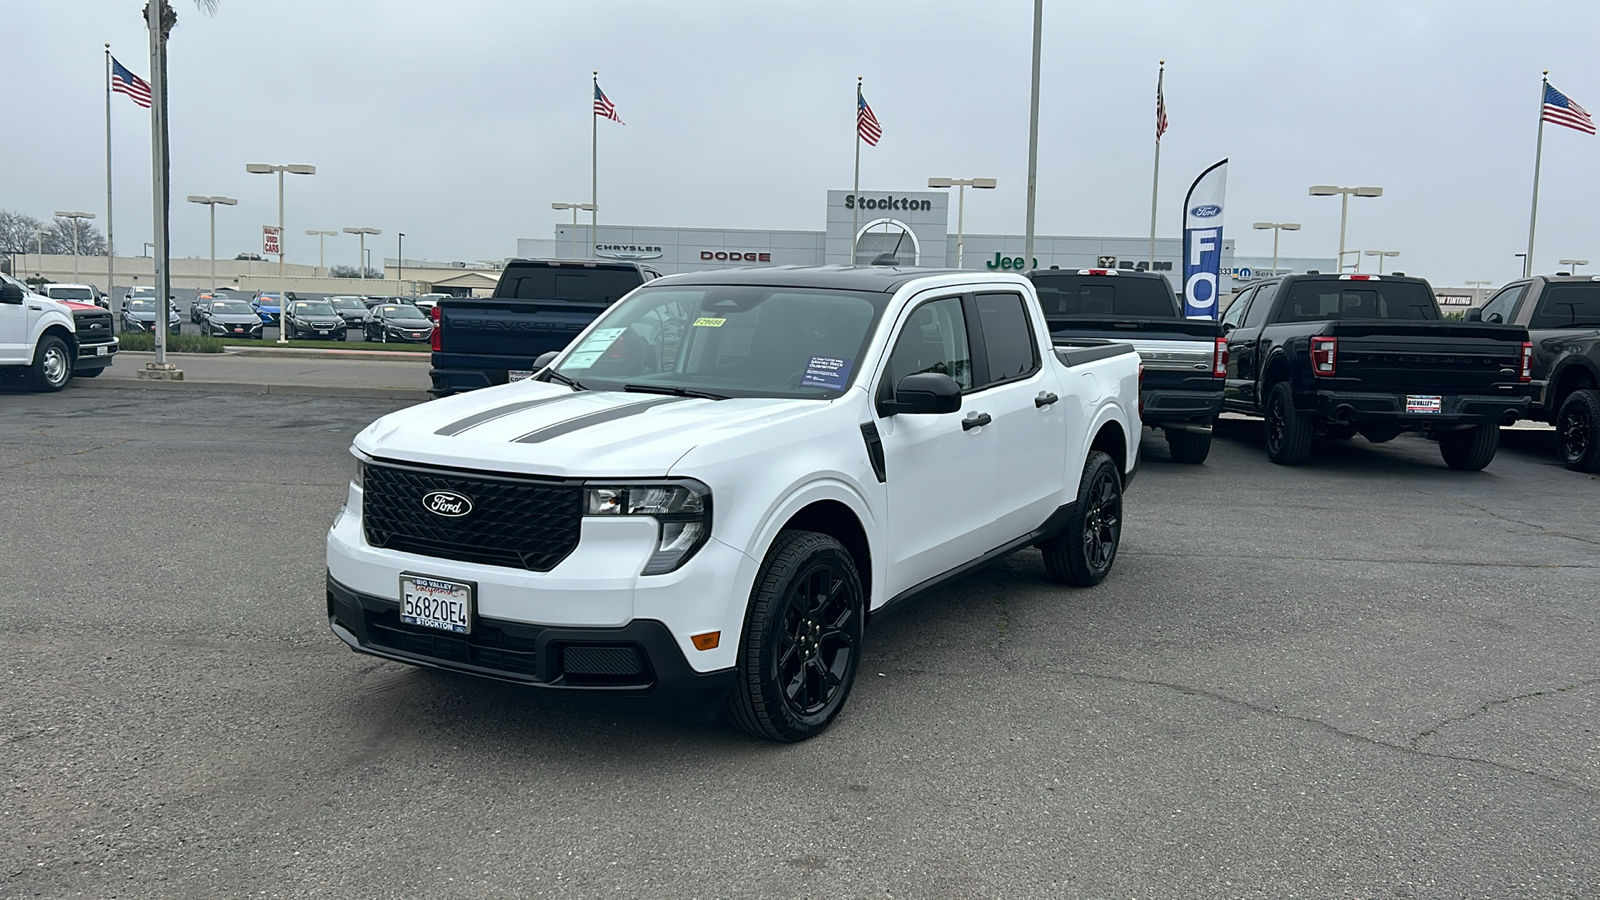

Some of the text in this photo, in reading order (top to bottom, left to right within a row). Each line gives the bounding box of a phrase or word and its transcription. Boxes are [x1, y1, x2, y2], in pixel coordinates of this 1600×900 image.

[844, 194, 931, 211] Stockton
[1196, 206, 1217, 217] Ford
[265, 235, 278, 243] USED
[265, 243, 279, 253] CARS
[595, 244, 661, 252] CHRYSLER
[700, 251, 770, 262] DODGE
[1119, 261, 1172, 271] RAM
[1185, 228, 1217, 320] FO
[1446, 296, 1471, 305] TINTING
[452, 319, 587, 333] CHEVROLE
[1367, 355, 1492, 364] PLATINUM
[431, 494, 462, 514] Ford
[428, 580, 452, 590] VALLEY
[405, 593, 467, 625] 56820E4
[416, 617, 453, 631] STOCKTON
